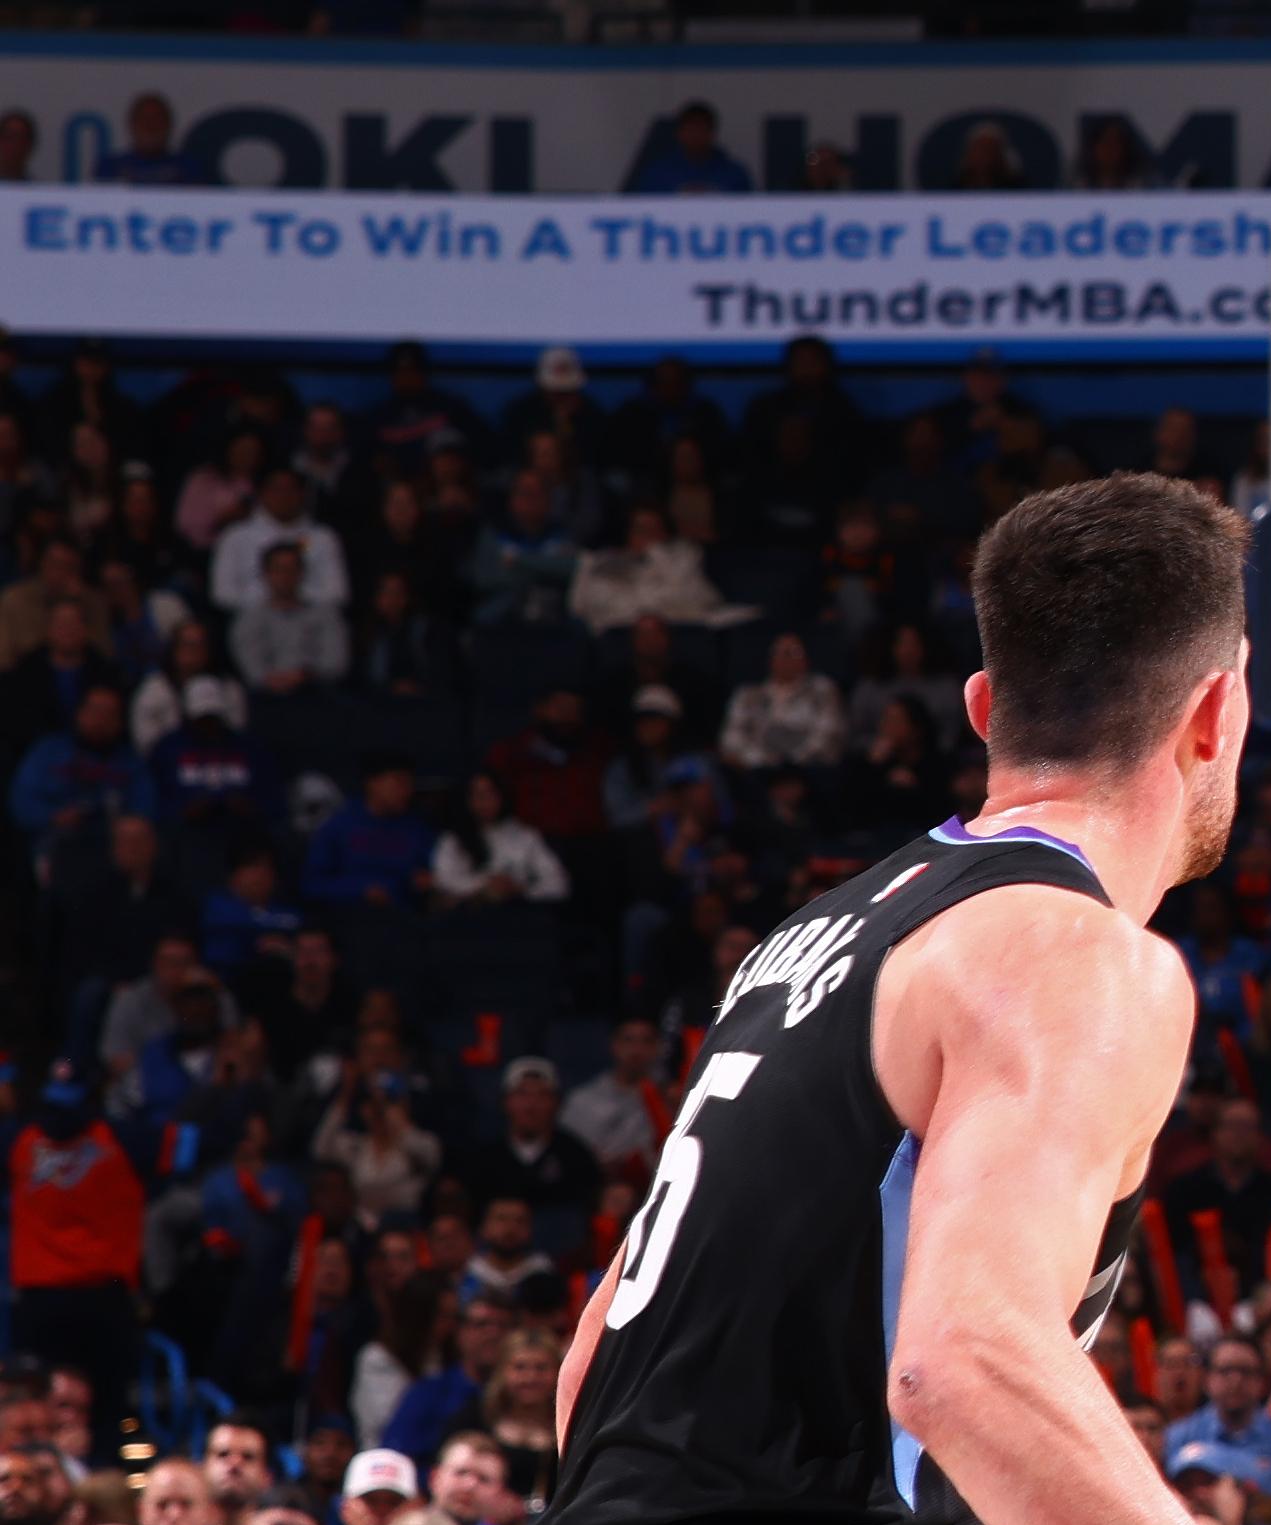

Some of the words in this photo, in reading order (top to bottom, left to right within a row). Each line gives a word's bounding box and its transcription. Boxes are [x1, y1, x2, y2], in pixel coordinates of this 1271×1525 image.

[23, 206, 233, 255] Enter
[252, 212, 342, 258] To
[362, 211, 501, 260] Win
[521, 218, 573, 261] A
[590, 214, 907, 262] Thunder
